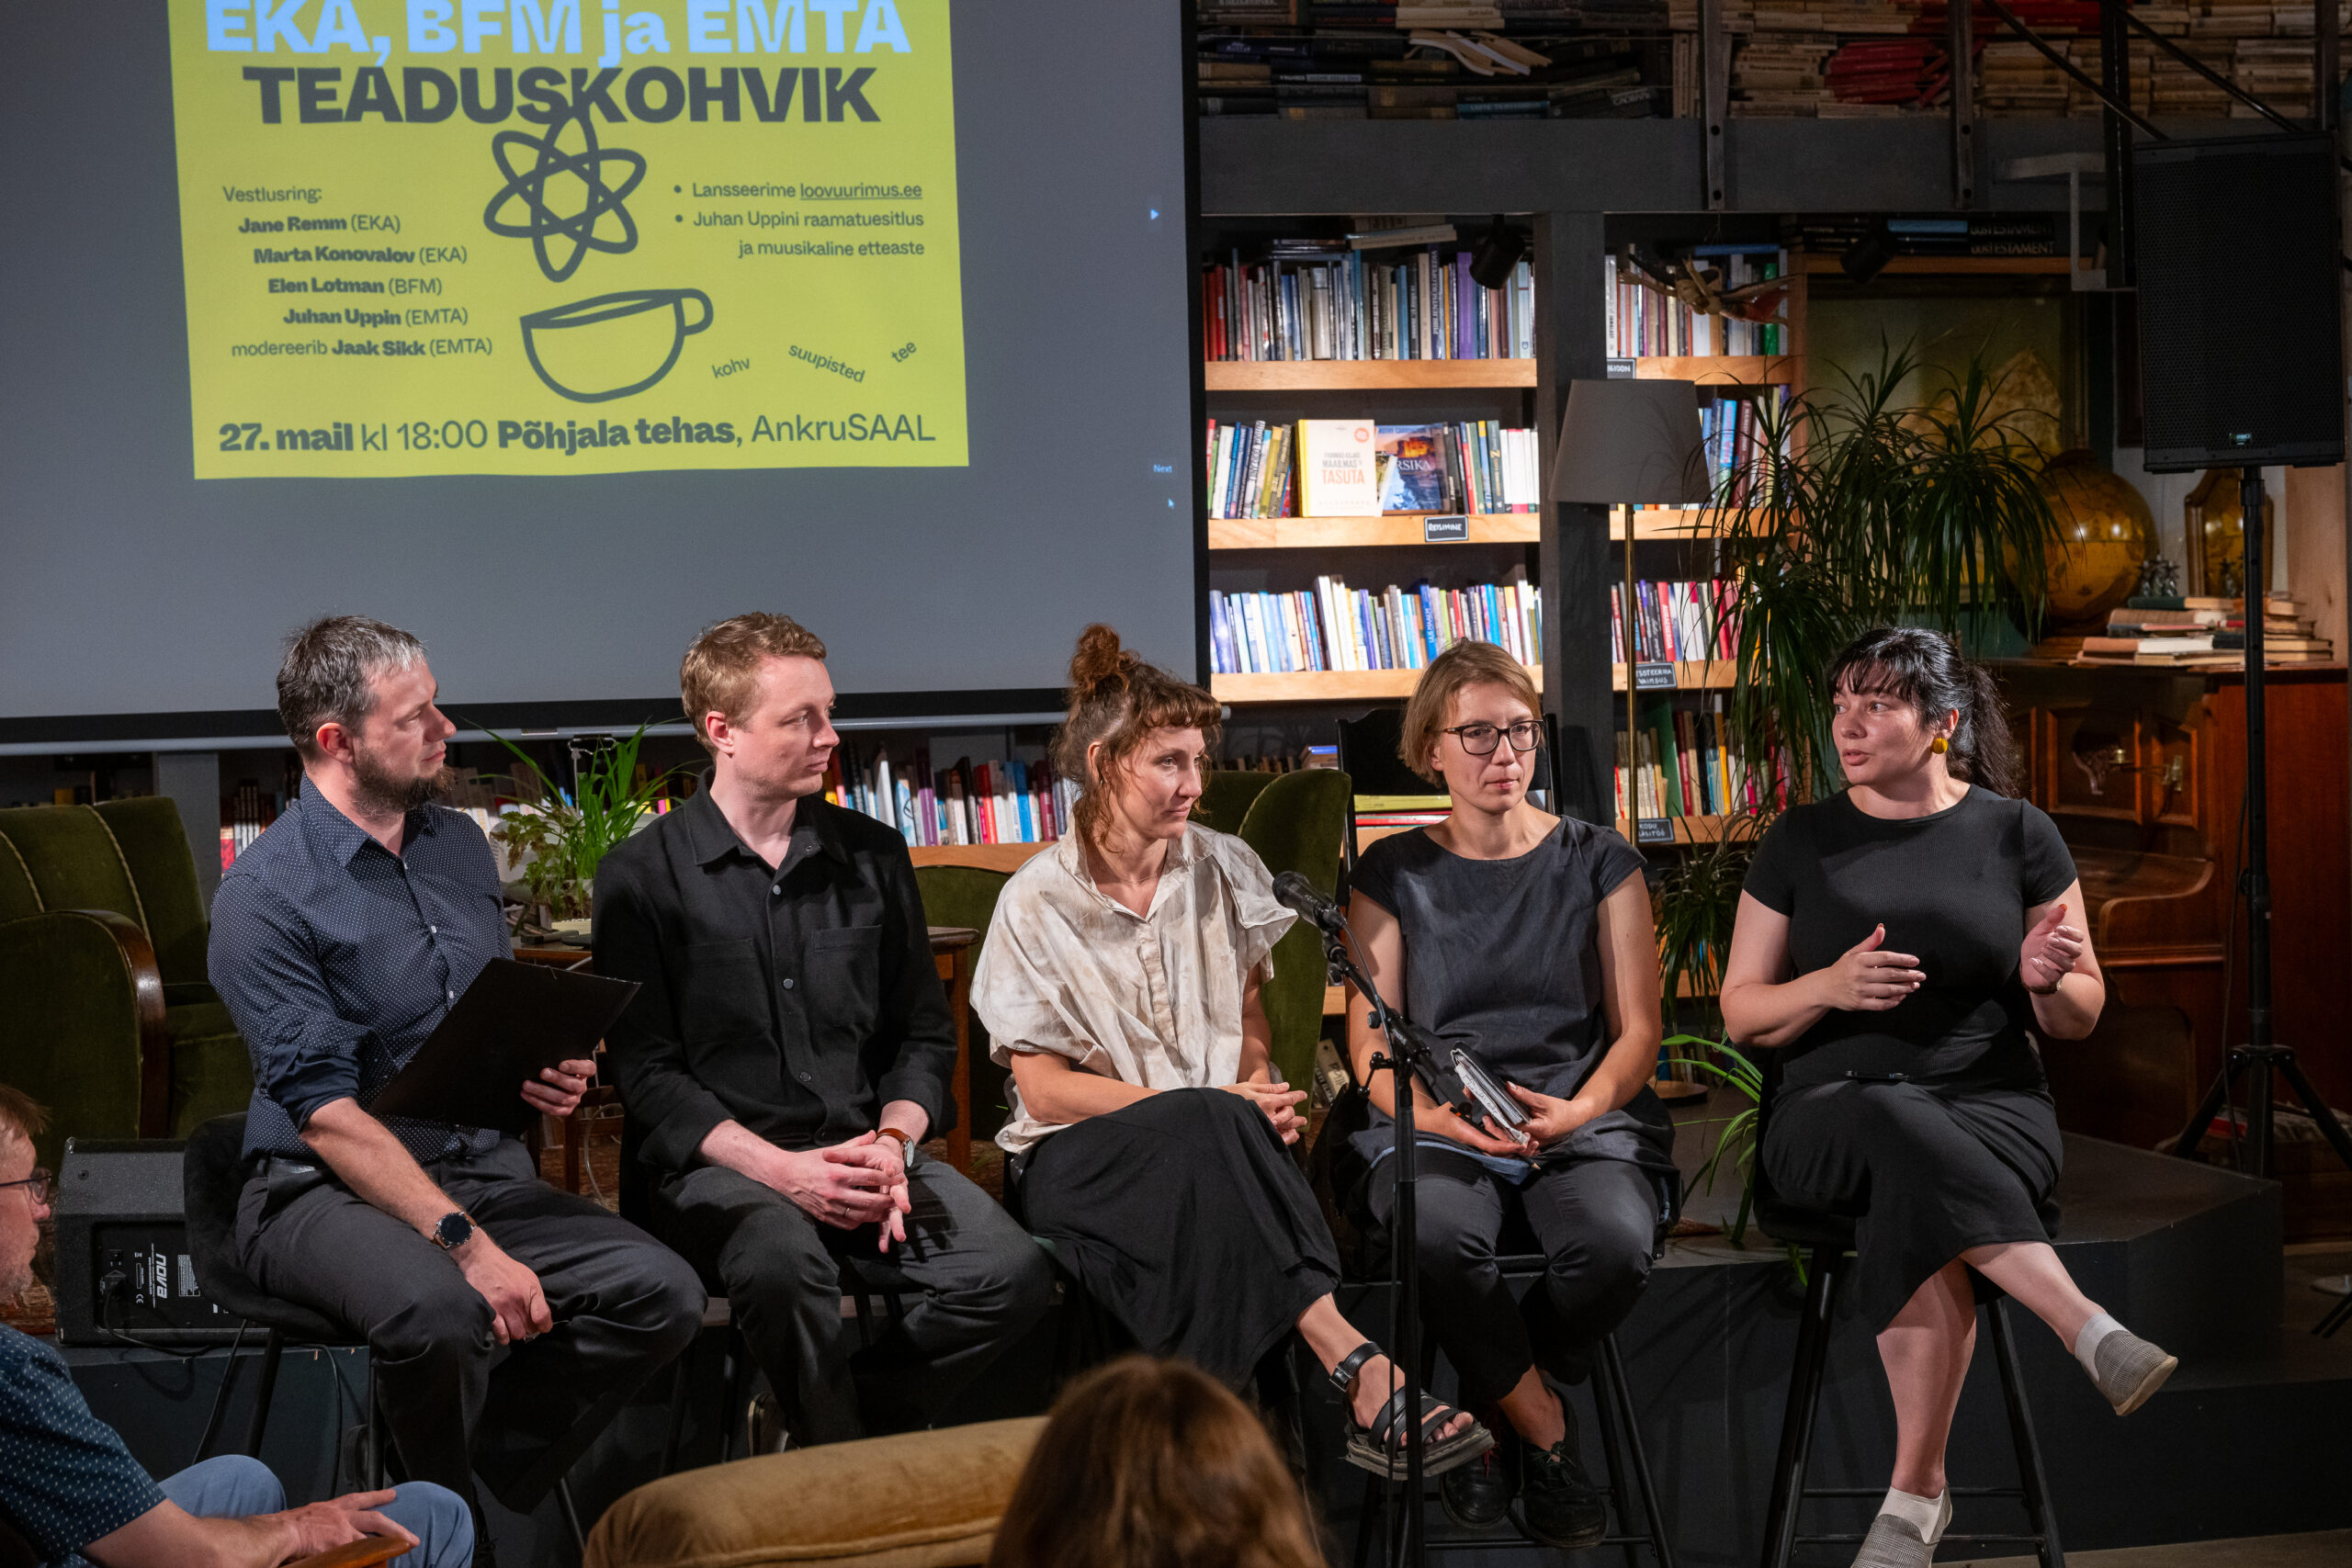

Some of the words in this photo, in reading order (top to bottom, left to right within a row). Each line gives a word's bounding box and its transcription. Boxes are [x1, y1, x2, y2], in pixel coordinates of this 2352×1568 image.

[206, 0, 391, 67] EKA,
[406, 0, 583, 54] BFM
[598, 0, 671, 68] ja
[686, 0, 912, 53] EMTA
[243, 65, 882, 124] TEADUSKOHVIK
[222, 186, 322, 204] Vestlusring:
[693, 183, 796, 197] Lansseerime
[800, 183, 923, 199] loovuurimus.ee
[239, 217, 284, 233] Jane
[288, 215, 347, 231] Remm
[351, 214, 401, 233] (EKA)
[693, 211, 743, 227] Juhan
[748, 211, 798, 229] Uppini
[804, 211, 924, 227] raamatuesitlus
[254, 247, 312, 264] Marta
[315, 245, 414, 263] Konovalov
[419, 244, 468, 265] (EKA)
[739, 241, 754, 257] ja
[758, 241, 854, 256] muusikaline
[858, 241, 925, 255] etteaste
[268, 278, 308, 293] Elen
[311, 277, 384, 293] Lotman
[389, 276, 442, 296] (BFM)
[283, 309, 341, 324] Juhan
[345, 309, 401, 328] Uppin
[405, 307, 469, 326] (EMTA)
[232, 341, 327, 356] modereerib
[332, 340, 379, 355] Jaak
[382, 340, 425, 355] Sikk
[429, 337, 492, 356] (EMTA)
[891, 341, 917, 364] tee
[712, 356, 751, 379] kohv
[788, 344, 865, 383] suupisted
[219, 423, 270, 451] 27.
[277, 423, 354, 451] mail
[361, 423, 388, 451] kl
[397, 420, 488, 450] 18:00
[497, 419, 629, 456] Põhjala
[635, 416, 743, 447] tehas,
[752, 413, 936, 442] AnkruSAAL
[1154, 464, 1172, 472] Next
[1396, 459, 1432, 471] RSIKA
[1321, 469, 1366, 485] TASUTA
[156, 1254, 167, 1299] nova
